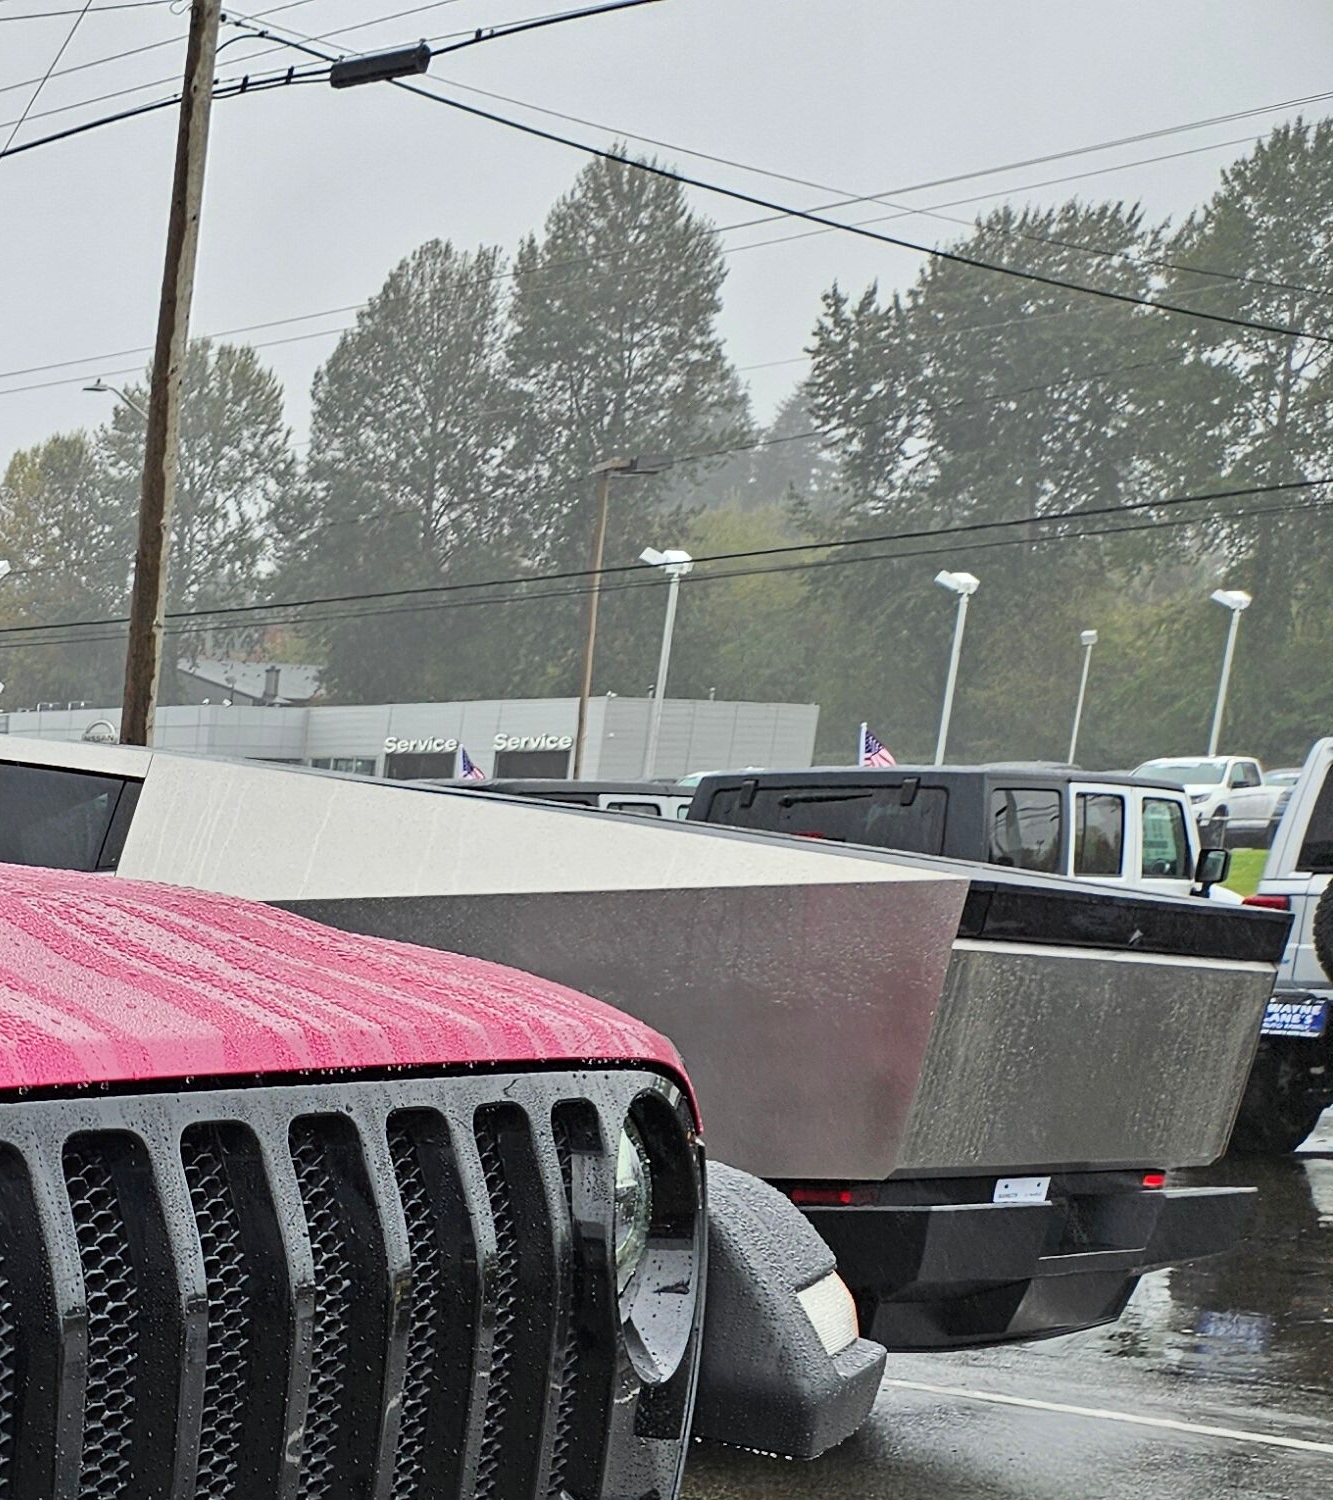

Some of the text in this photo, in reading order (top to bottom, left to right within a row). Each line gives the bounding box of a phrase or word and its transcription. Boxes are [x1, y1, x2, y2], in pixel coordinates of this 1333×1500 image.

[82, 734, 116, 743] NISSAN
[384, 735, 459, 753] Service
[493, 733, 574, 751] Service
